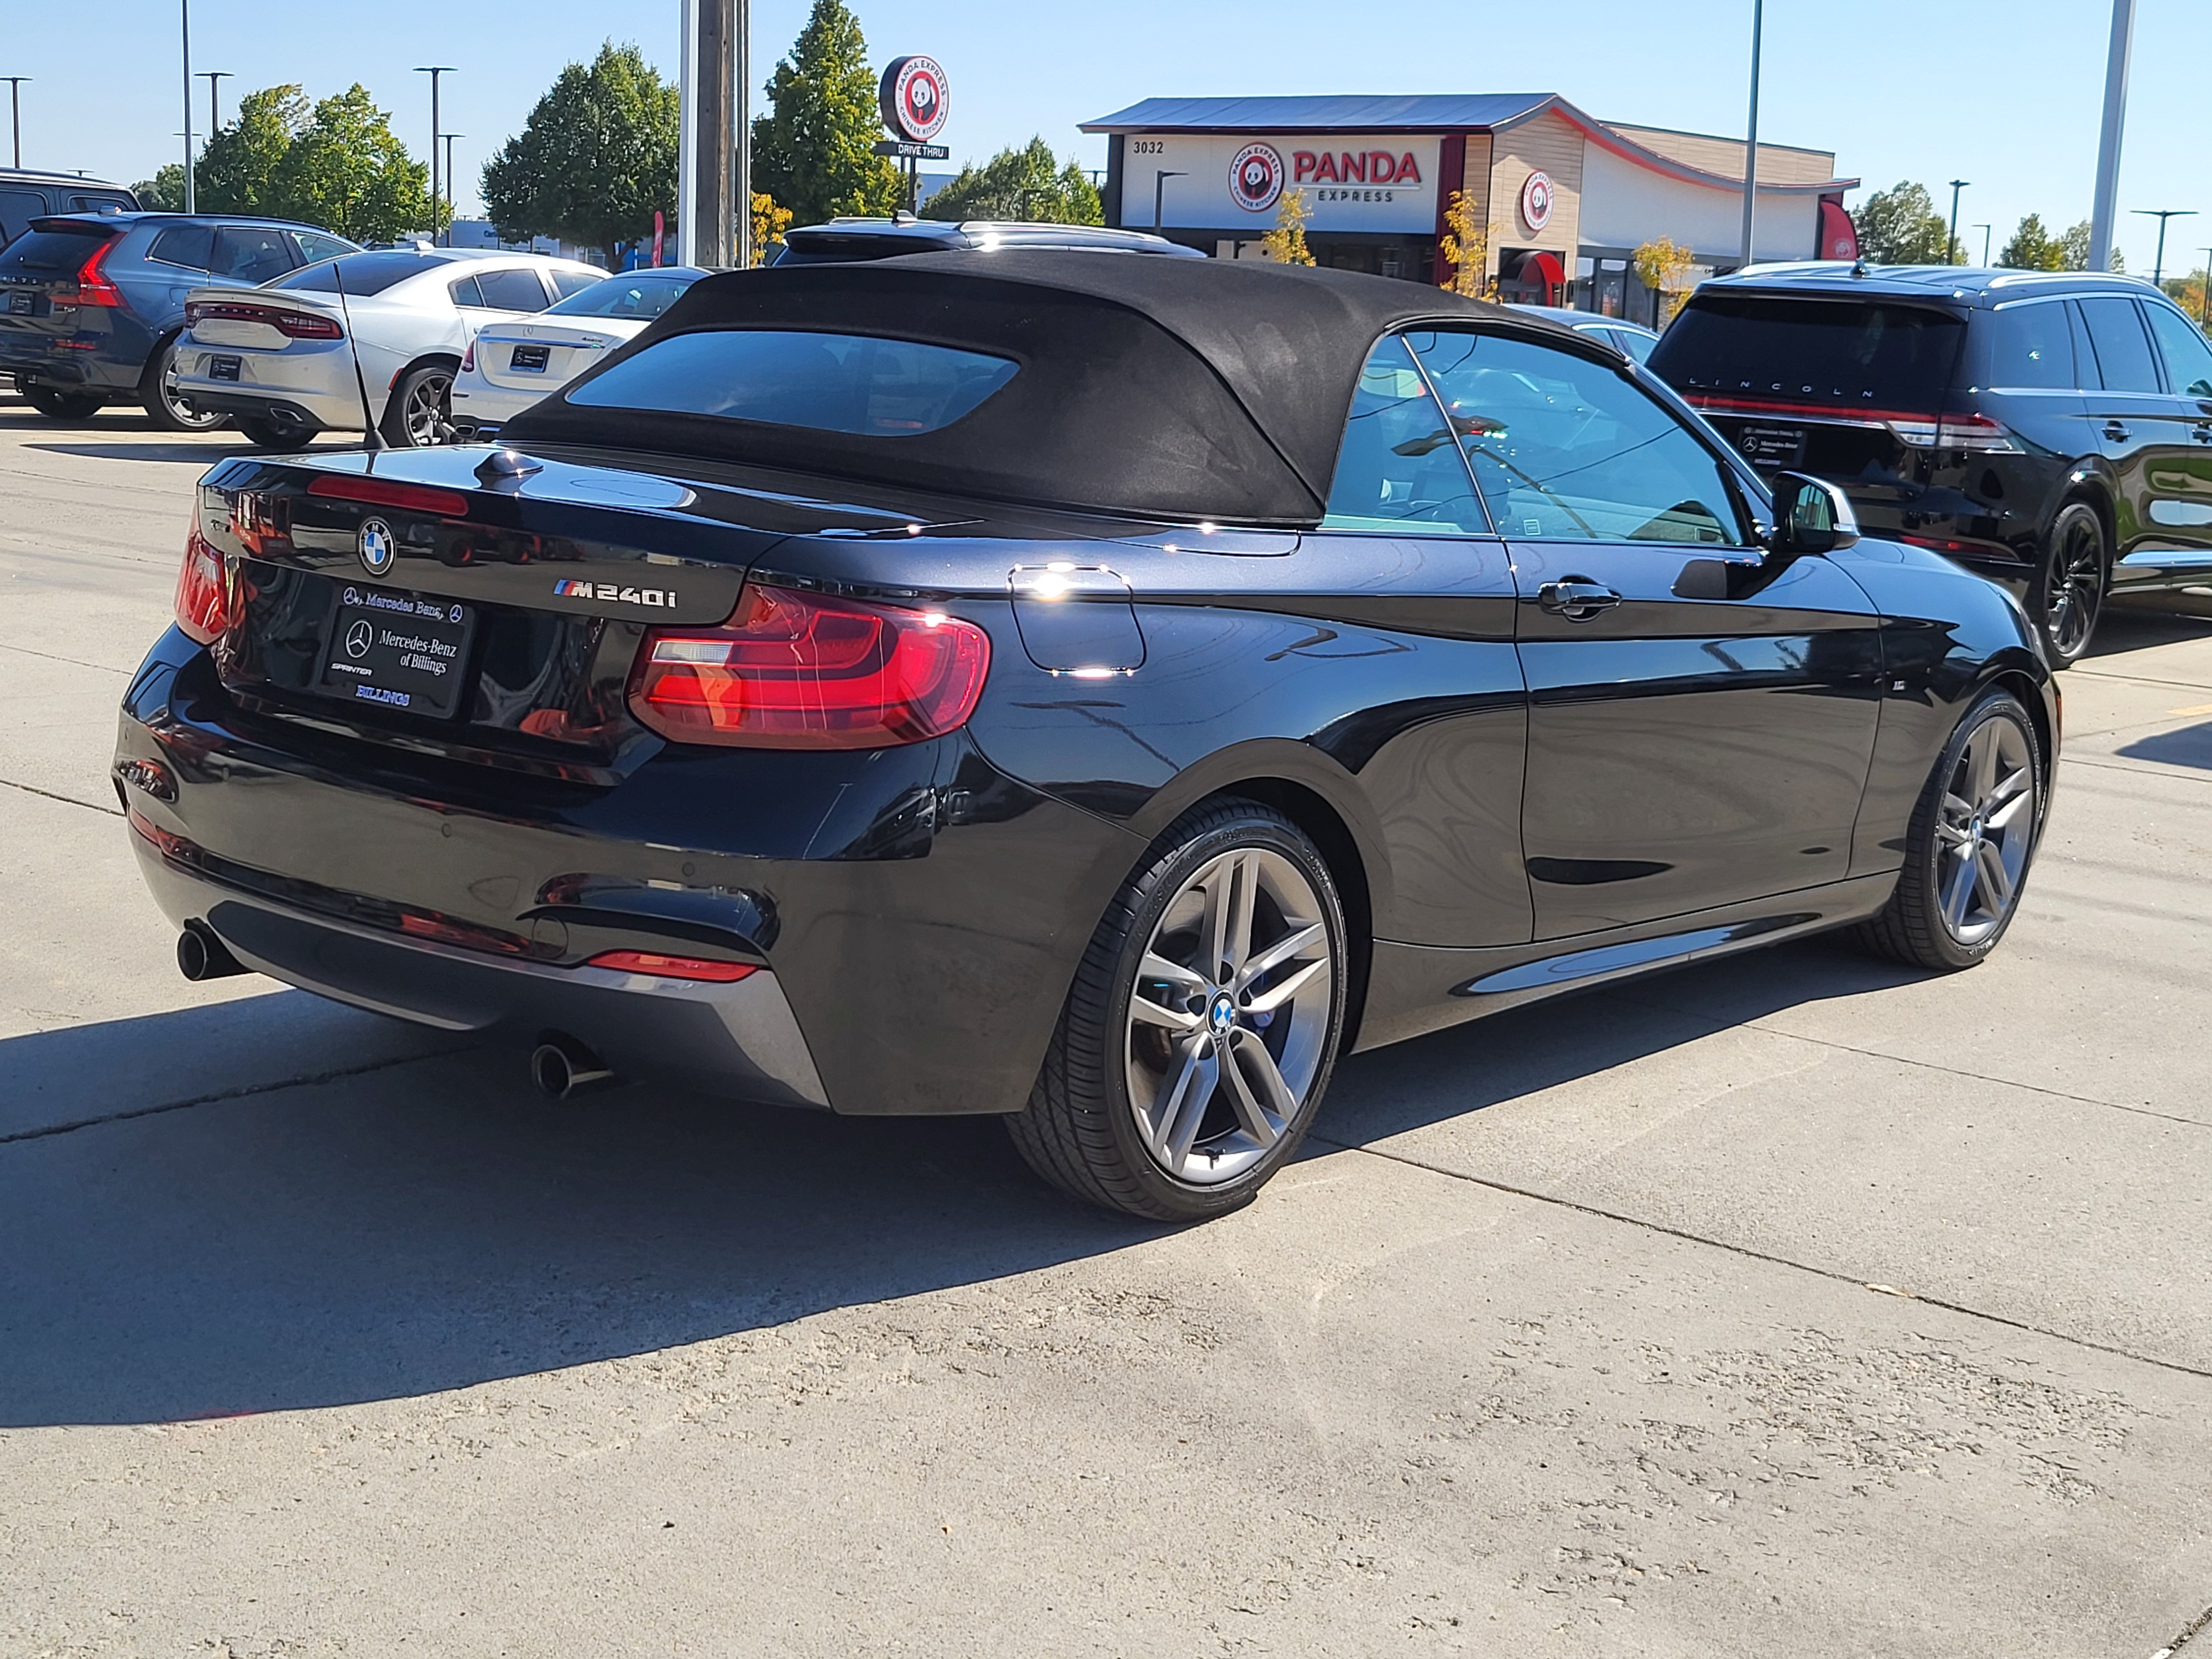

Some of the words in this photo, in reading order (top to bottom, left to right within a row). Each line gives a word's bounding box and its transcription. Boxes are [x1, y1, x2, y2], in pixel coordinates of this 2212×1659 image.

[899, 61, 919, 91] PANDA
[921, 60, 946, 96] EXPRESS
[899, 106, 920, 134] CHINESE
[922, 112, 944, 134] KITCHEN
[898, 144, 922, 155] DRIVE
[922, 146, 945, 158] THRU
[1133, 141, 1164, 154] 3032
[1232, 149, 1252, 175] PANDA
[1254, 147, 1279, 175] EXPRESS
[1292, 152, 1422, 183] PANDA
[1317, 190, 1393, 202] EXPRESS
[1689, 377, 1873, 398] LINCOLN
[365, 592, 414, 612] Mercedes
[378, 629, 457, 658] Mercedes-Benz
[331, 662, 373, 676] SPRINTER
[400, 653, 413, 667] of
[411, 653, 447, 676] Billings
[356, 685, 411, 707] BILLINGS
